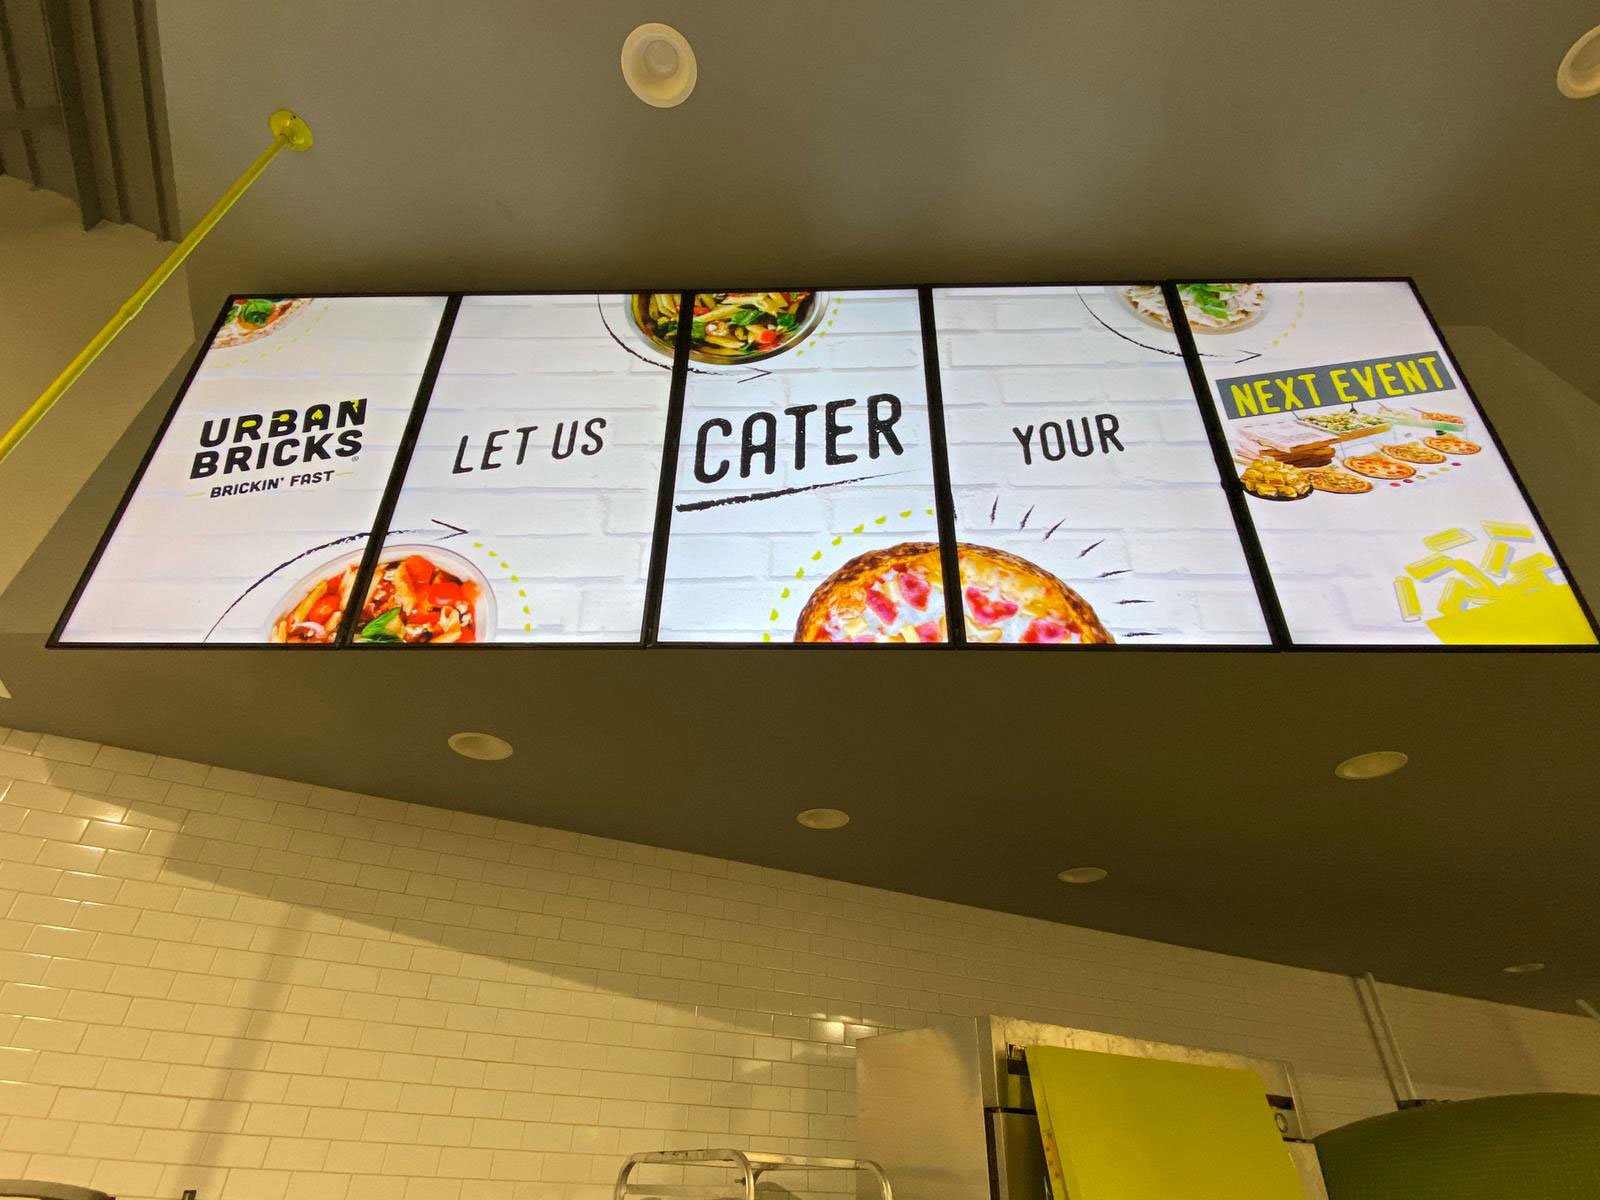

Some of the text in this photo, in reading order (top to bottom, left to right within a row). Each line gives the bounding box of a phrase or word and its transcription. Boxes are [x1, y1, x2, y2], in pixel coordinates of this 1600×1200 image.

[1230, 356, 1444, 417] NEXT EVENT
[200, 398, 367, 448] URBAN
[452, 418, 607, 474] LET US
[694, 393, 904, 484] CATER
[1012, 413, 1125, 465] YOUR
[189, 430, 364, 480] BRICKS
[210, 470, 335, 498] BRICKIN' FAST
